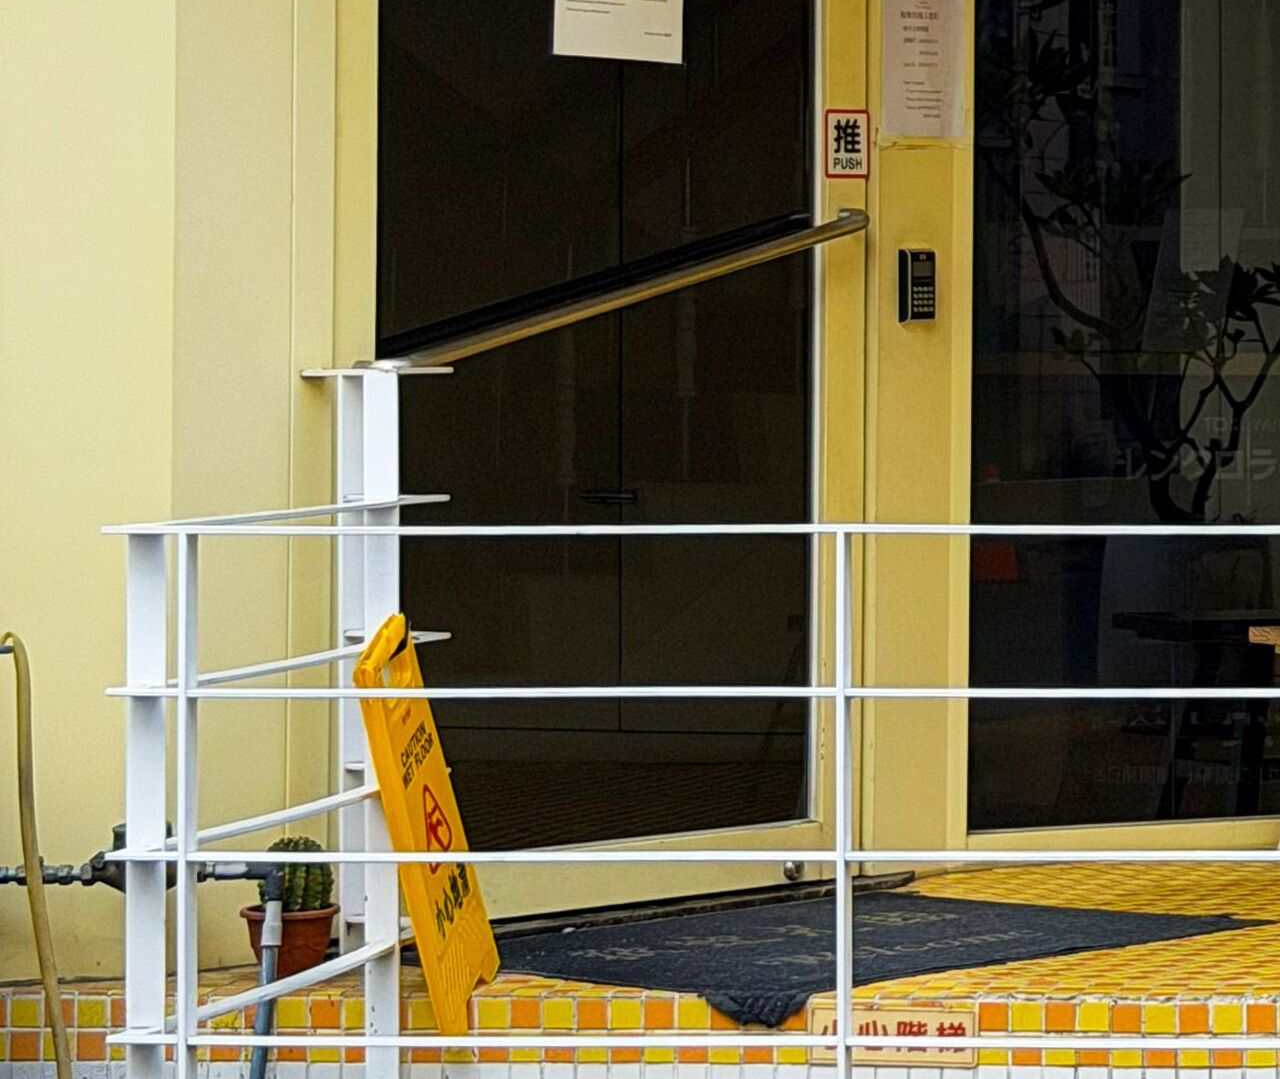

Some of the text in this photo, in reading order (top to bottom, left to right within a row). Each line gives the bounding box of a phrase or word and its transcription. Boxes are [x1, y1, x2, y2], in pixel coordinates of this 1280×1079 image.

[833, 118, 862, 154] 推
[833, 157, 863, 171] PUSH
[400, 719, 427, 769] CAUTION
[402, 731, 435, 790] WET FLOOR
